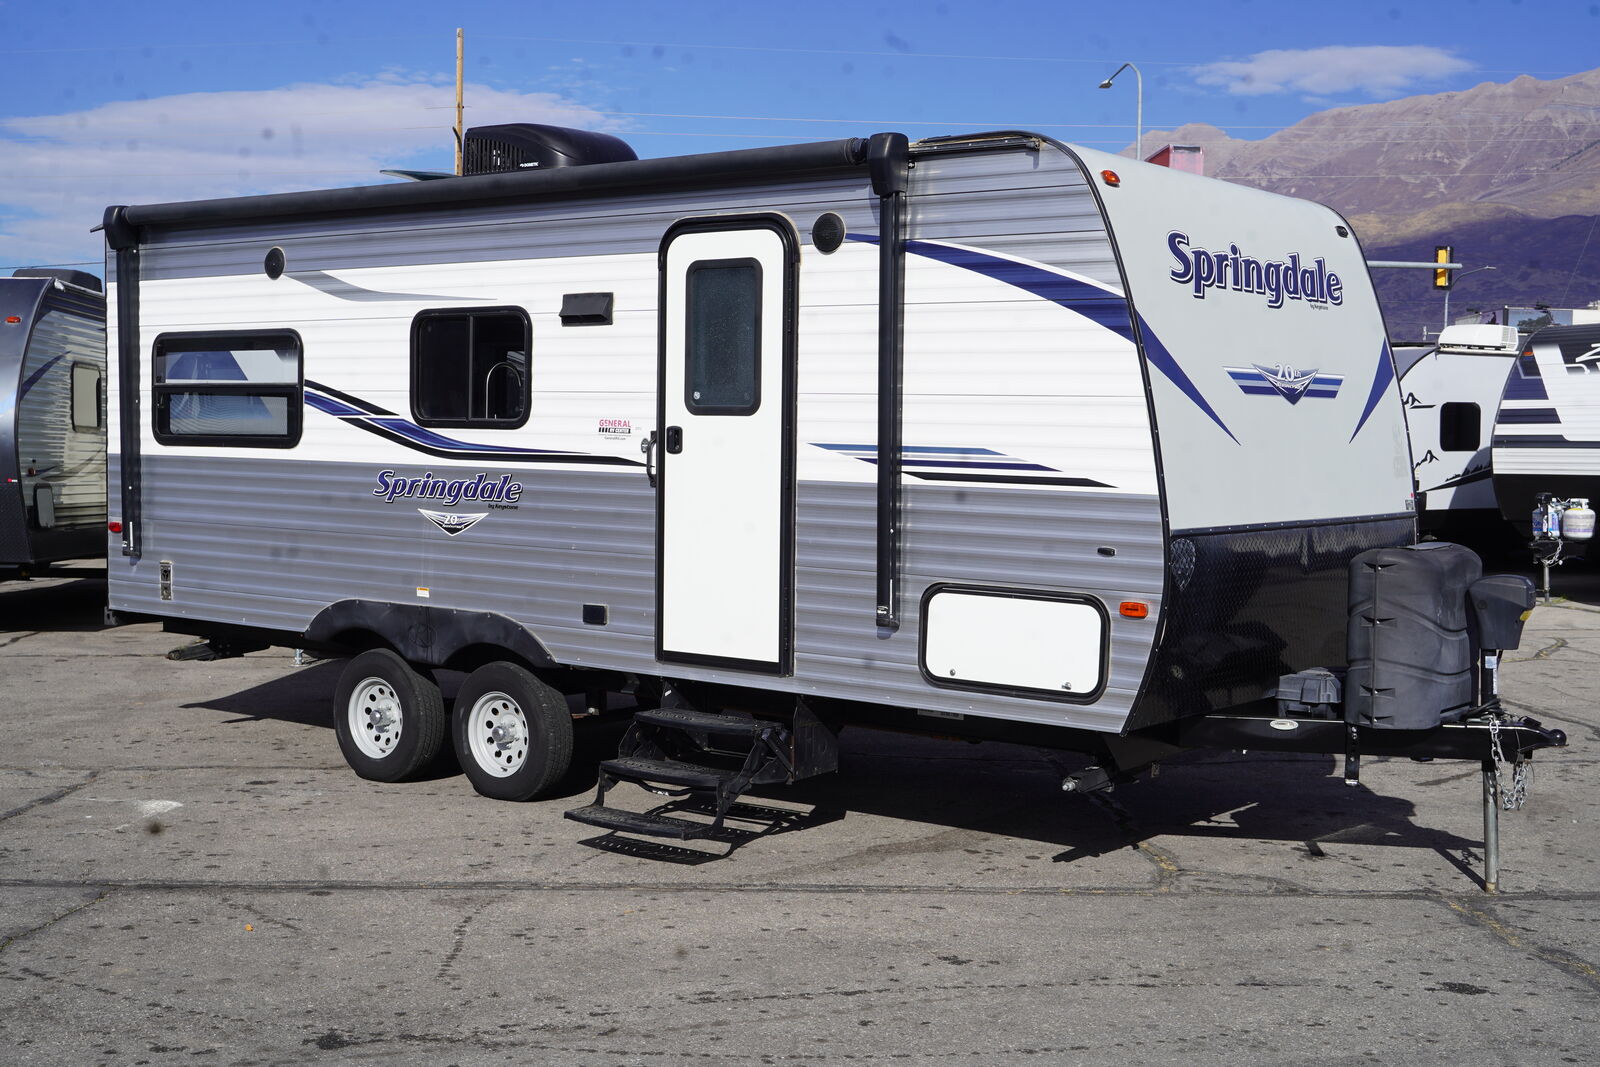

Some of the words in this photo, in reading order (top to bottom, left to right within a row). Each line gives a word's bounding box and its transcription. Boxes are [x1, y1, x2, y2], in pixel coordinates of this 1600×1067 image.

[1166, 230, 1343, 309] Springdale
[599, 419, 632, 428] GENERAL
[373, 469, 523, 507] Springdale
